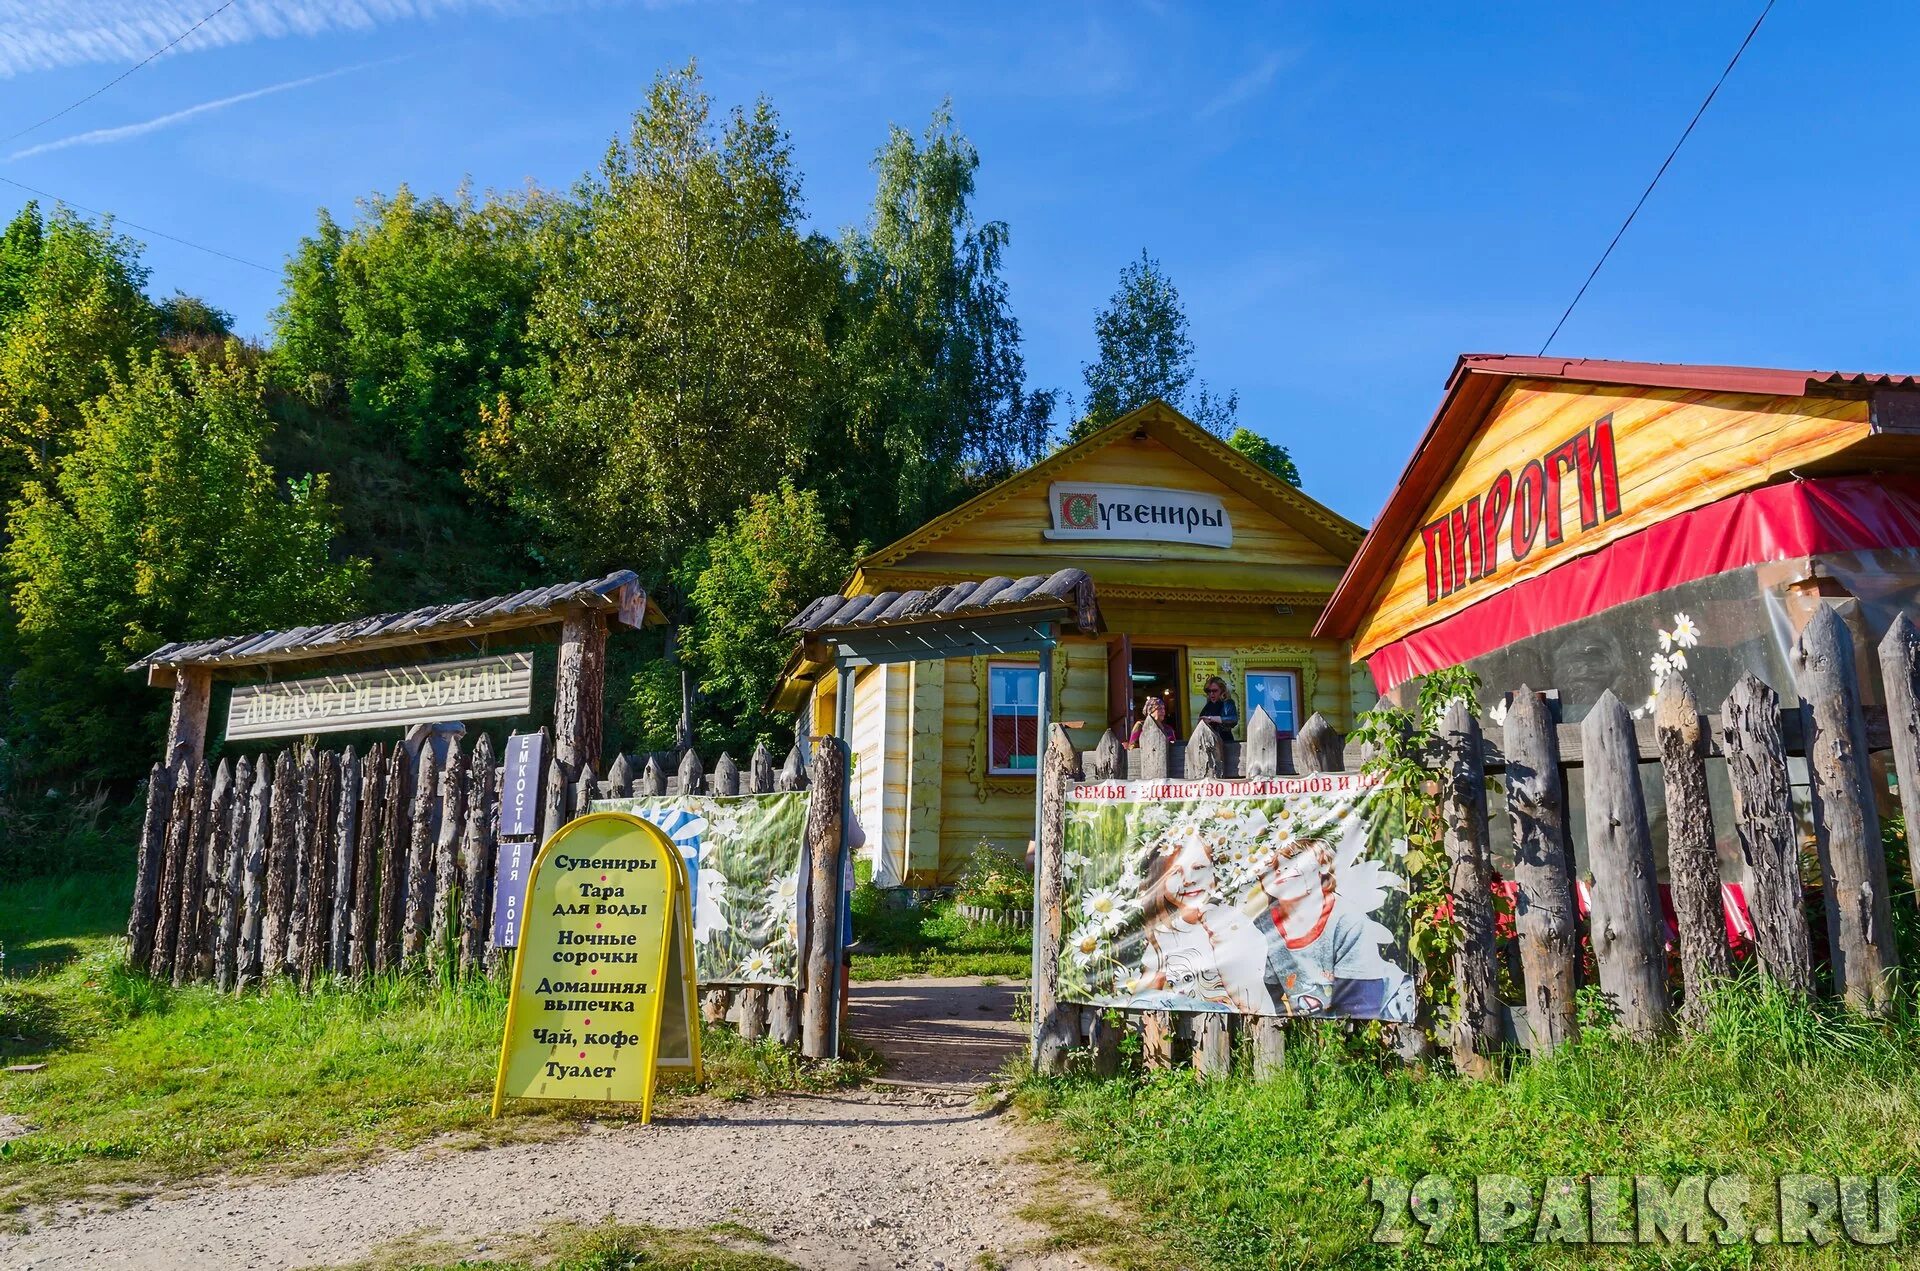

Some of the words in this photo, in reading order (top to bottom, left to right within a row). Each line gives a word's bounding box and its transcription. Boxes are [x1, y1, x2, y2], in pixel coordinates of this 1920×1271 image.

[1059, 492, 1223, 535] Сувениры
[1420, 412, 1623, 607] ПИРОГИ
[243, 678, 373, 725] МИЛОСТИ
[376, 657, 513, 712] ПРОСИМ!
[1074, 784, 1127, 800] СЕМЬЯ
[1140, 783, 1225, 801] ЕДИНСТВО
[1229, 777, 1333, 796] ПОМЫСЛОВ
[1337, 776, 1350, 791] И
[509, 844, 522, 881] ДЛЯ
[554, 854, 658, 872] Сувениры
[578, 883, 626, 901] Тара
[552, 904, 594, 916] для
[595, 903, 648, 916] воды
[504, 895, 517, 947] ВОДЫ
[556, 930, 637, 946] Ночные
[552, 951, 639, 966] сорочки
[534, 977, 648, 996] Домашняя
[543, 1000, 635, 1013] выпечка
[532, 1028, 578, 1047] Чай,
[583, 1029, 640, 1048] кофе
[545, 1061, 616, 1081] Туалет
